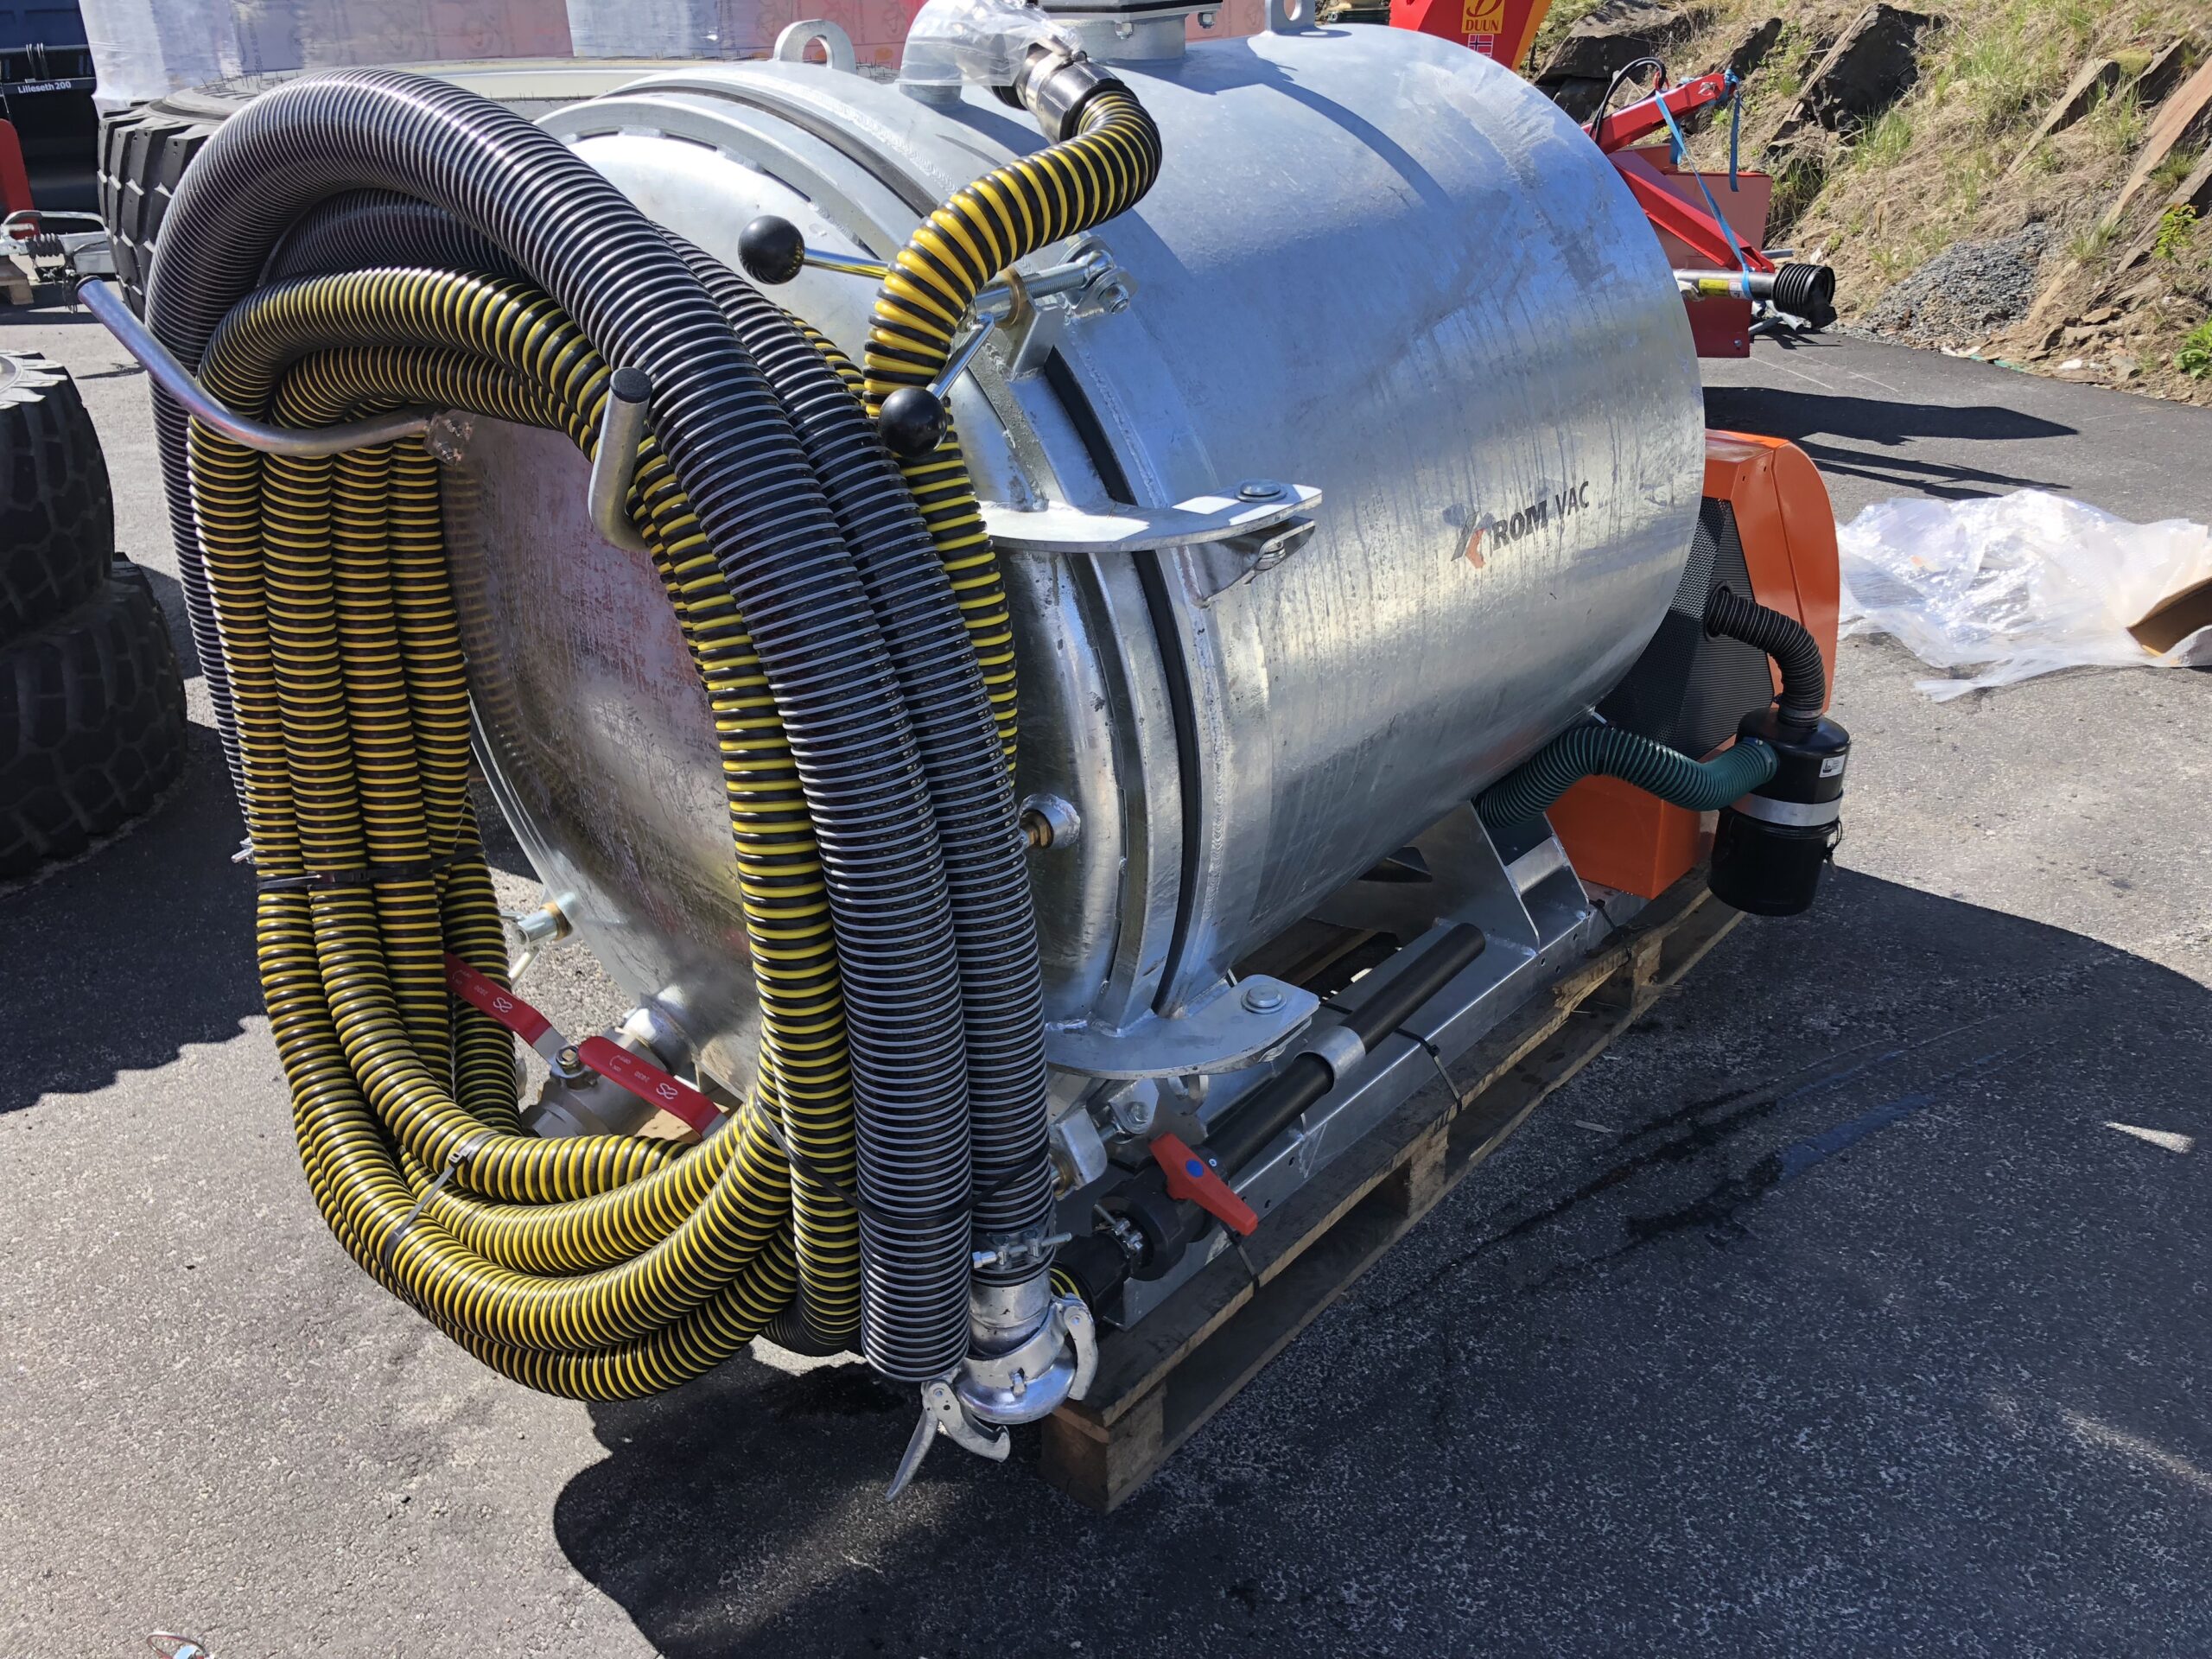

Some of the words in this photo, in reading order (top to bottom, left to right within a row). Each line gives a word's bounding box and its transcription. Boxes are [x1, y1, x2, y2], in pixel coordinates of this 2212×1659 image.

[1465, 19, 1499, 32] DUUN
[17, 82, 54, 93] Lilleseth
[54, 80, 72, 90] 200
[1555, 481, 1589, 519] VAC
